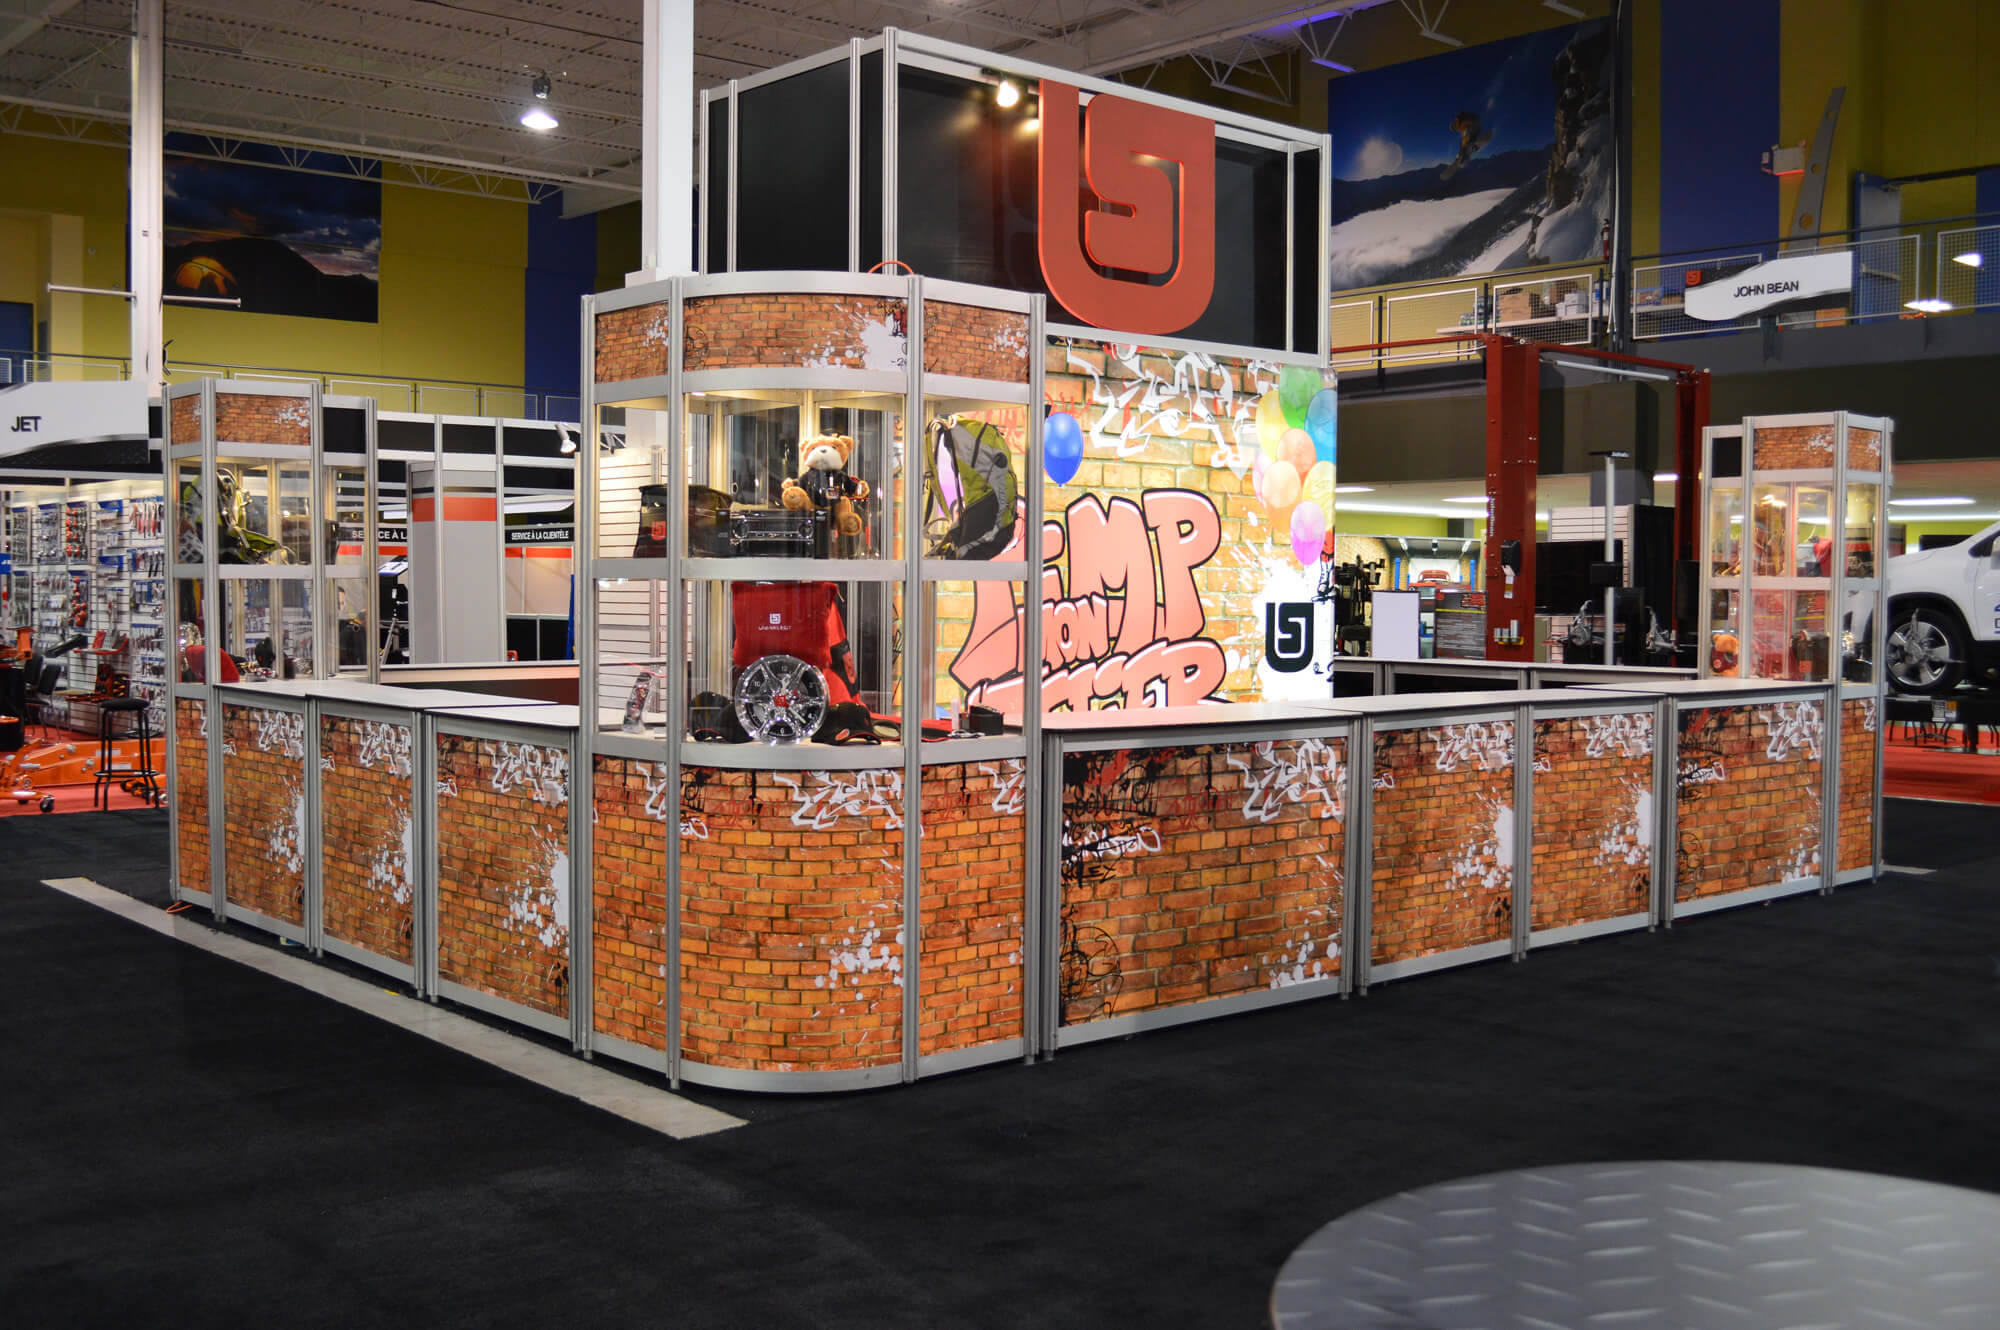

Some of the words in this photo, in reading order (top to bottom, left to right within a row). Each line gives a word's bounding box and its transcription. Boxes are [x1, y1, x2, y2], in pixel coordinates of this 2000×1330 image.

[1733, 283, 1765, 298] JOHN
[1767, 280, 1799, 294] BEAN
[10, 416, 42, 432] JET
[351, 530, 390, 540] SECE
[511, 531, 531, 541] SERVICE
